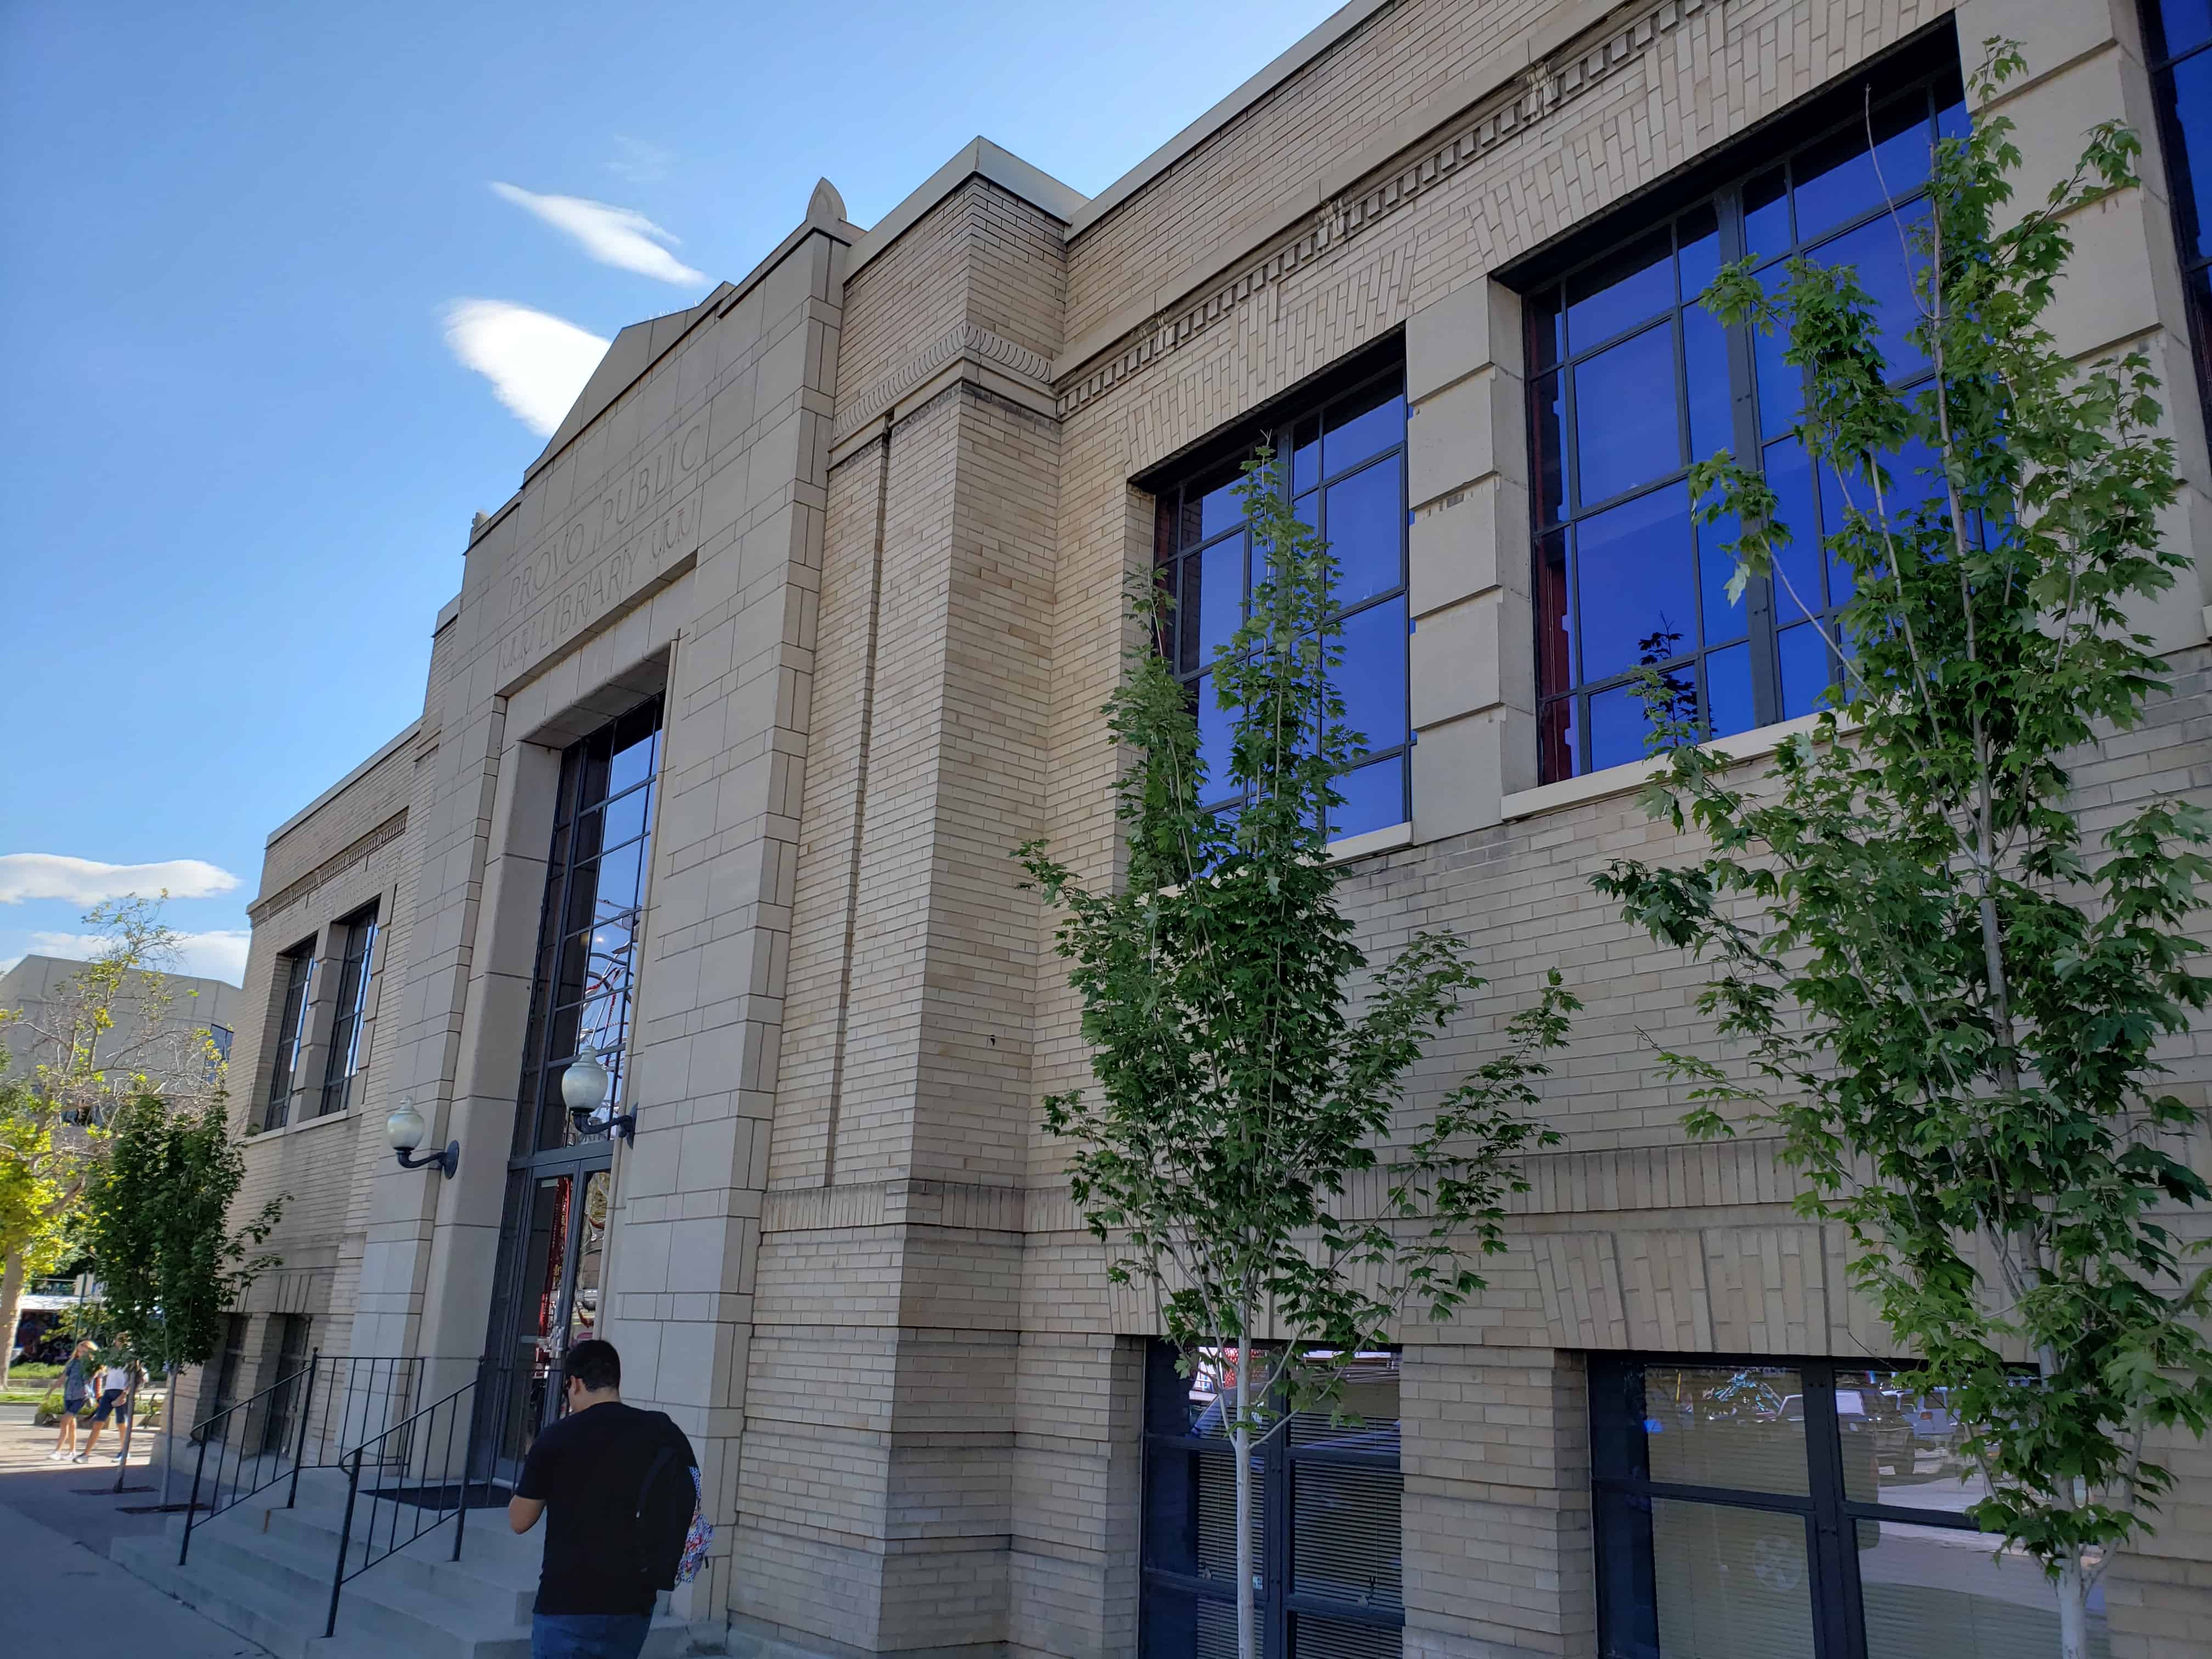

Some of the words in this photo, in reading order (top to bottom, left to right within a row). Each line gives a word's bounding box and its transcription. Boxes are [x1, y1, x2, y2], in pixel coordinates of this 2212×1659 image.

[508, 523, 585, 615] PROVO
[600, 425, 701, 545] PUBLIC
[539, 537, 644, 652] LIBRARY
